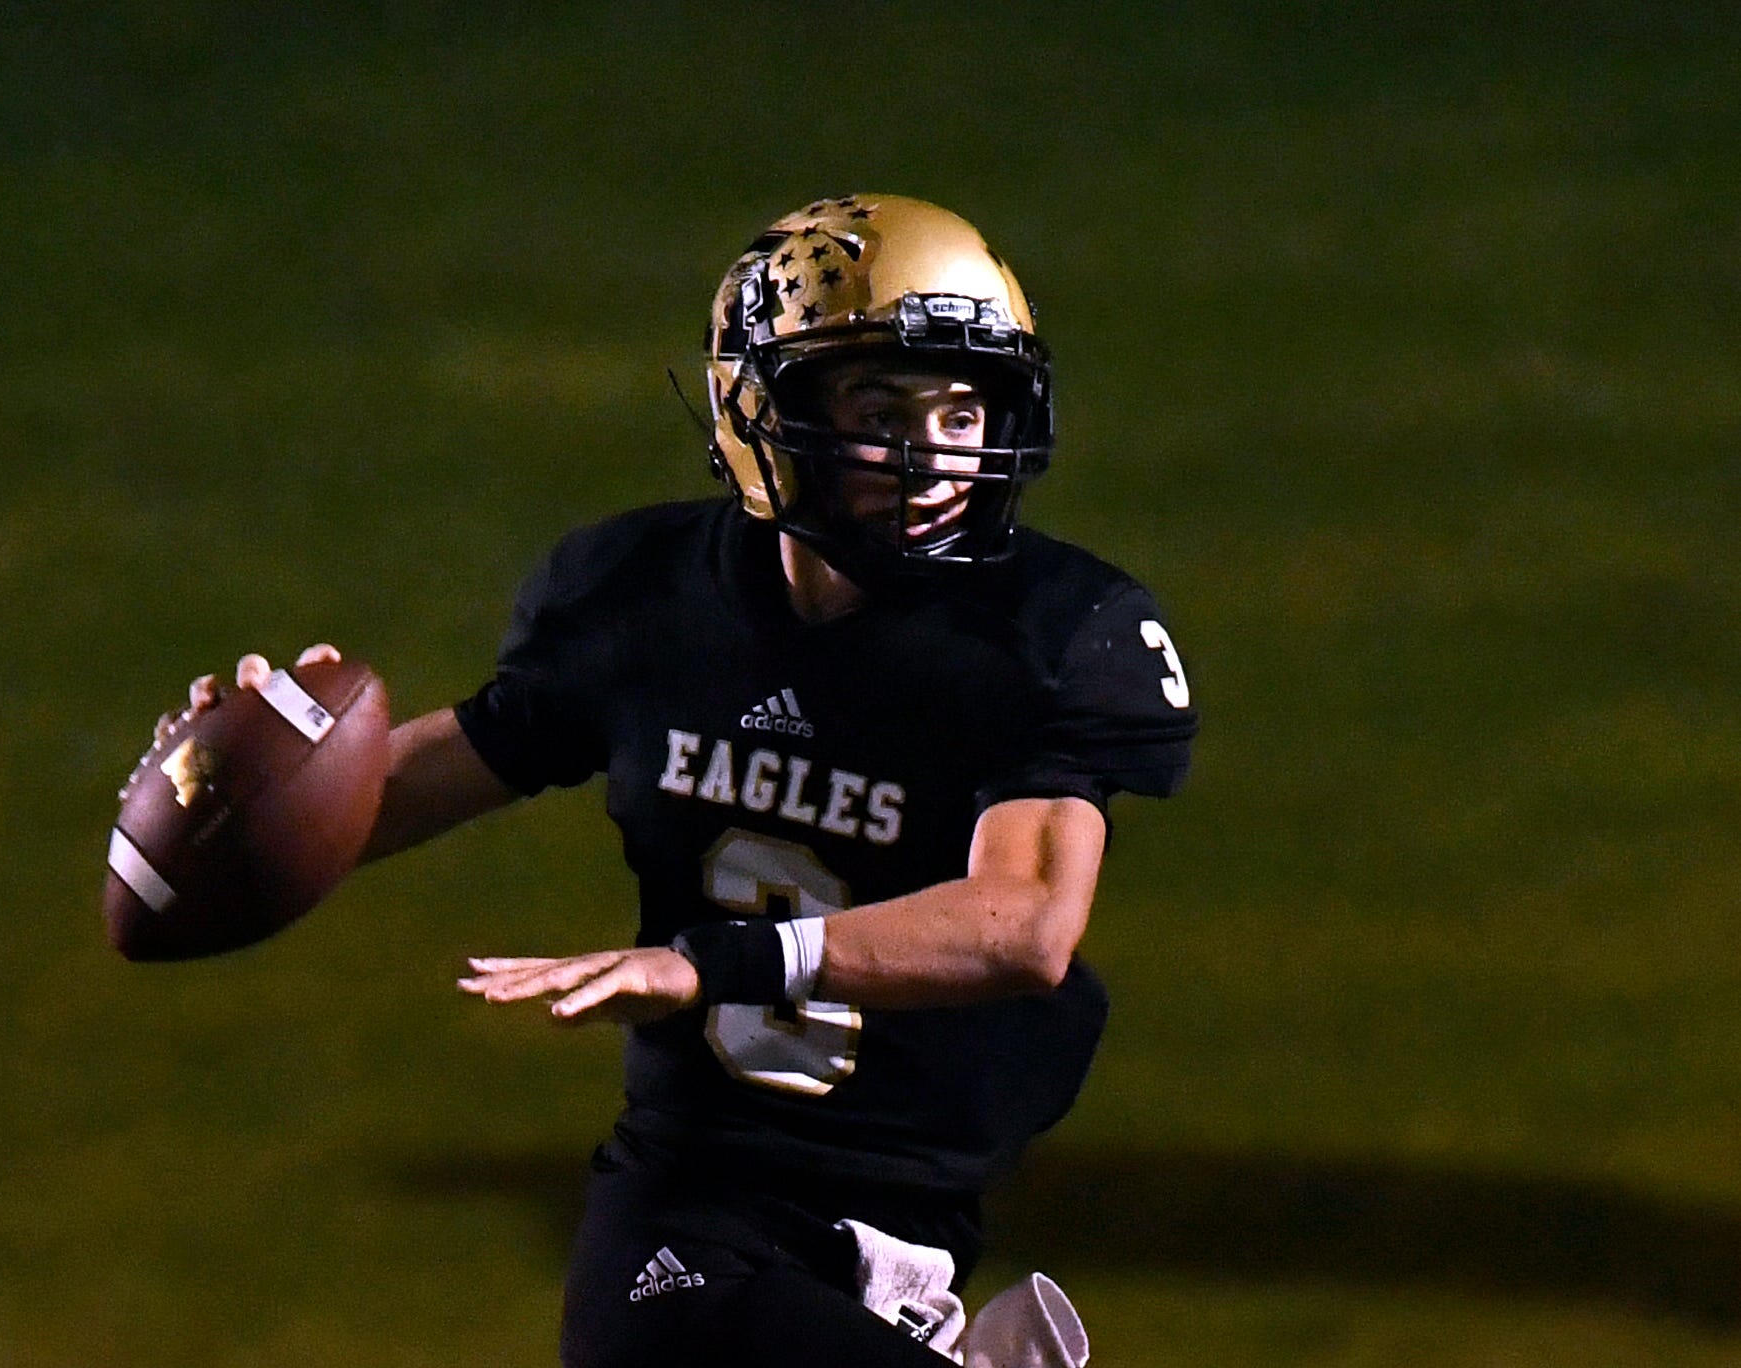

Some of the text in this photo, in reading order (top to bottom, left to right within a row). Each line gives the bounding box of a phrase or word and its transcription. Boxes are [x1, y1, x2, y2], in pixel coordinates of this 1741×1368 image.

[1140, 620, 1189, 708] 3
[740, 711, 815, 739] adidas
[658, 728, 907, 846] EAGLES
[630, 1272, 705, 1302] adidas
